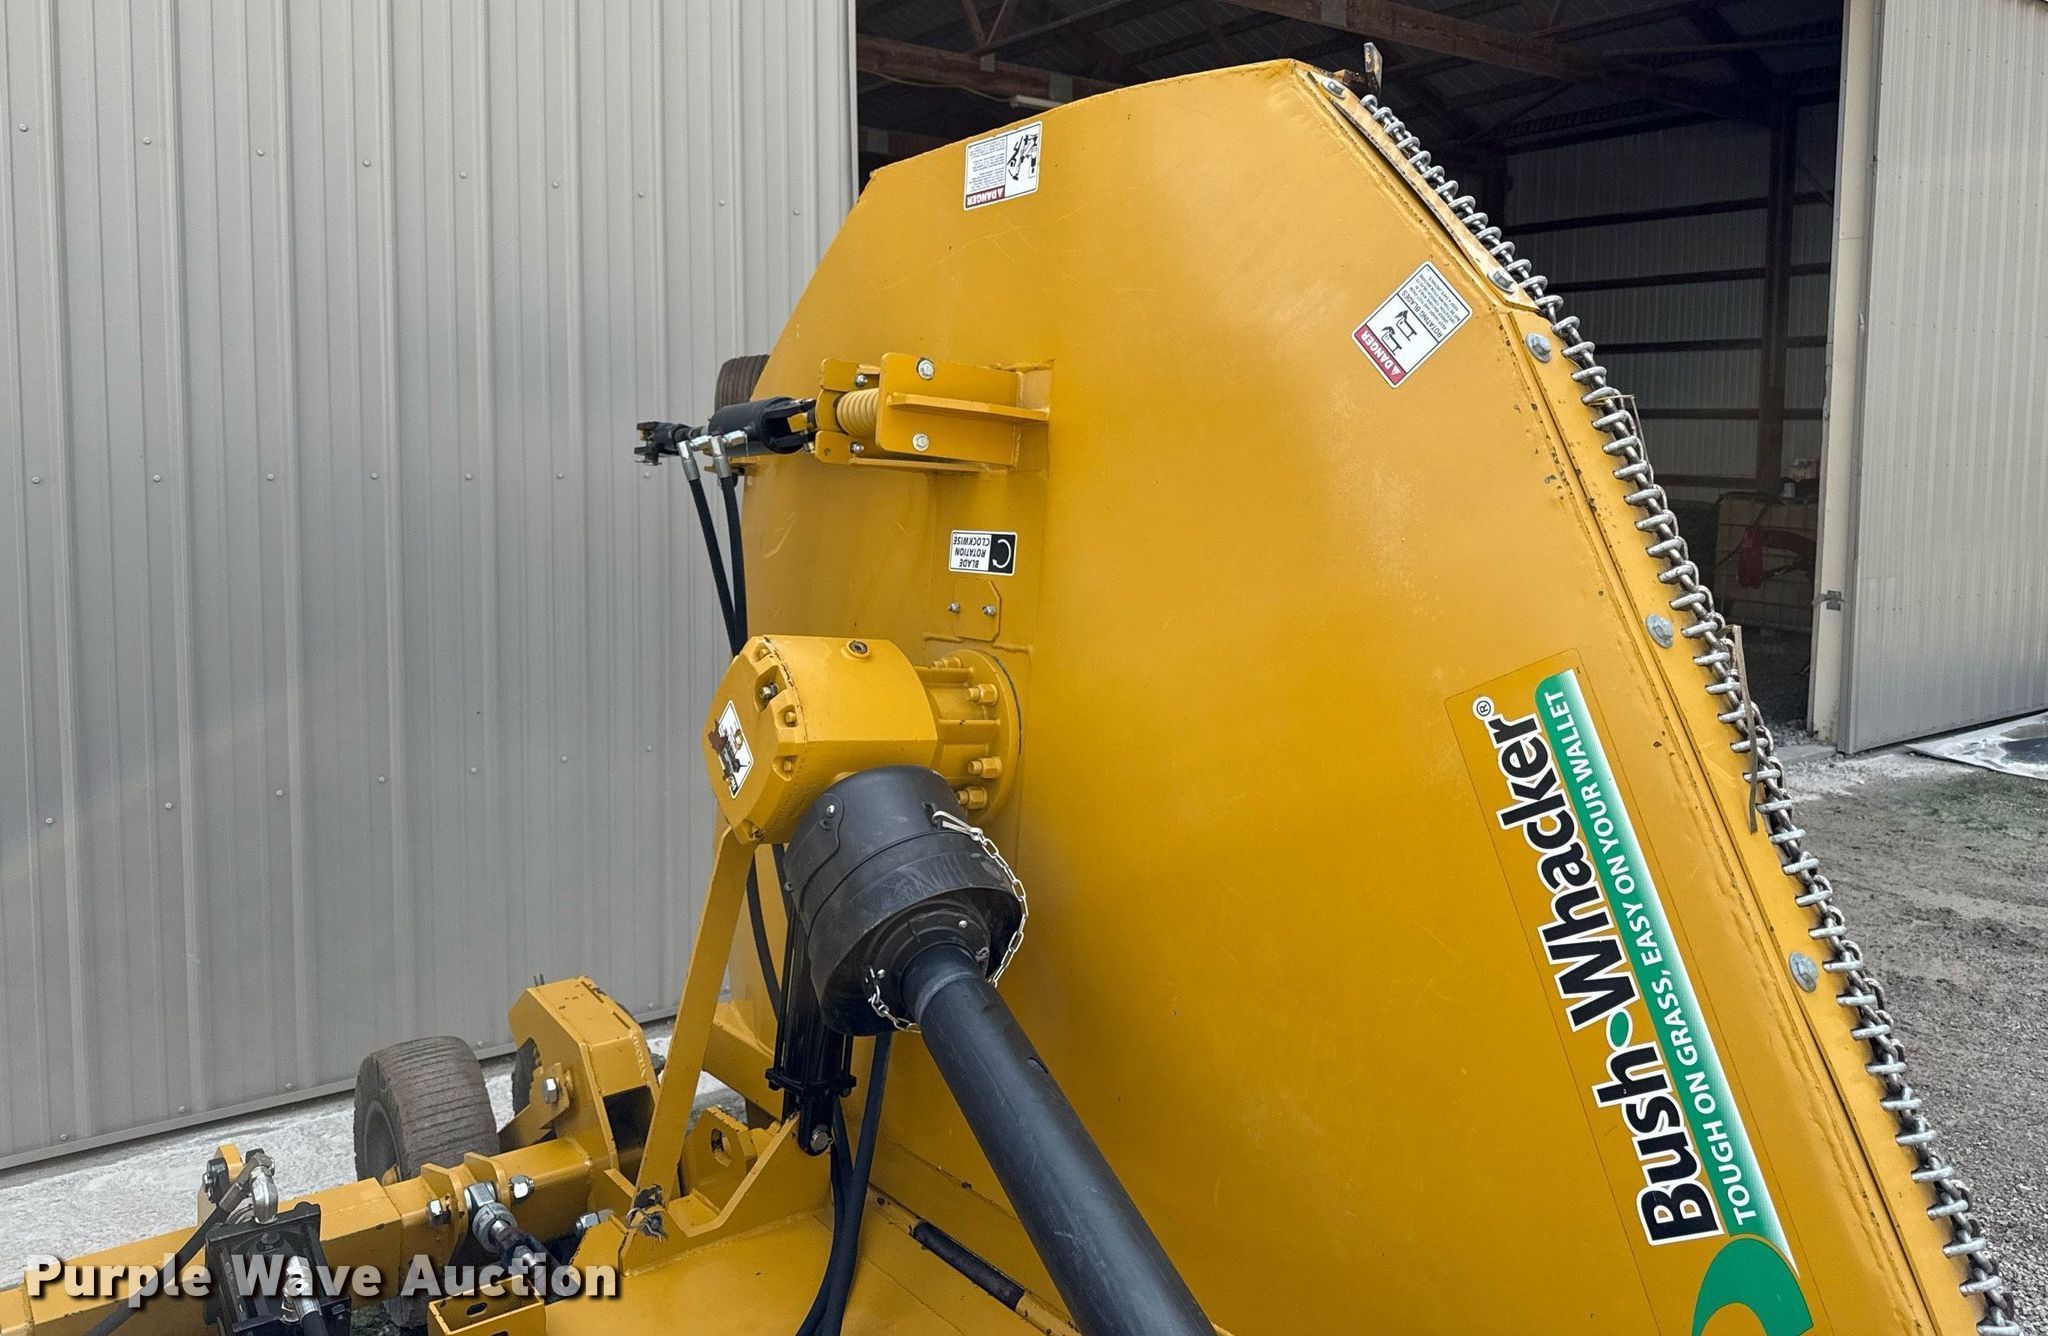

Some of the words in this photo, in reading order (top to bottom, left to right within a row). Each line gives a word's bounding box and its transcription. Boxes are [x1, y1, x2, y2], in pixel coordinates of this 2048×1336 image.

[967, 191, 997, 206] DANGER
[1401, 289, 1422, 313] BLADES
[1418, 309, 1443, 338] ROTATING
[1360, 330, 1394, 370] DANGER
[953, 536, 990, 546] CLOCKWISE
[955, 548, 986, 557] ROTATION
[959, 559, 979, 568] BLADE
[1544, 690, 1593, 783] WALLET
[1580, 781, 1619, 854] YOUR
[1606, 854, 1635, 894] ON
[1624, 902, 1663, 967] EASY
[1651, 967, 1699, 1062] GRASS,
[1685, 1071, 1717, 1112] ON
[1594, 1042, 1723, 1245] Bush
[1703, 1119, 1757, 1226] TOUGH
